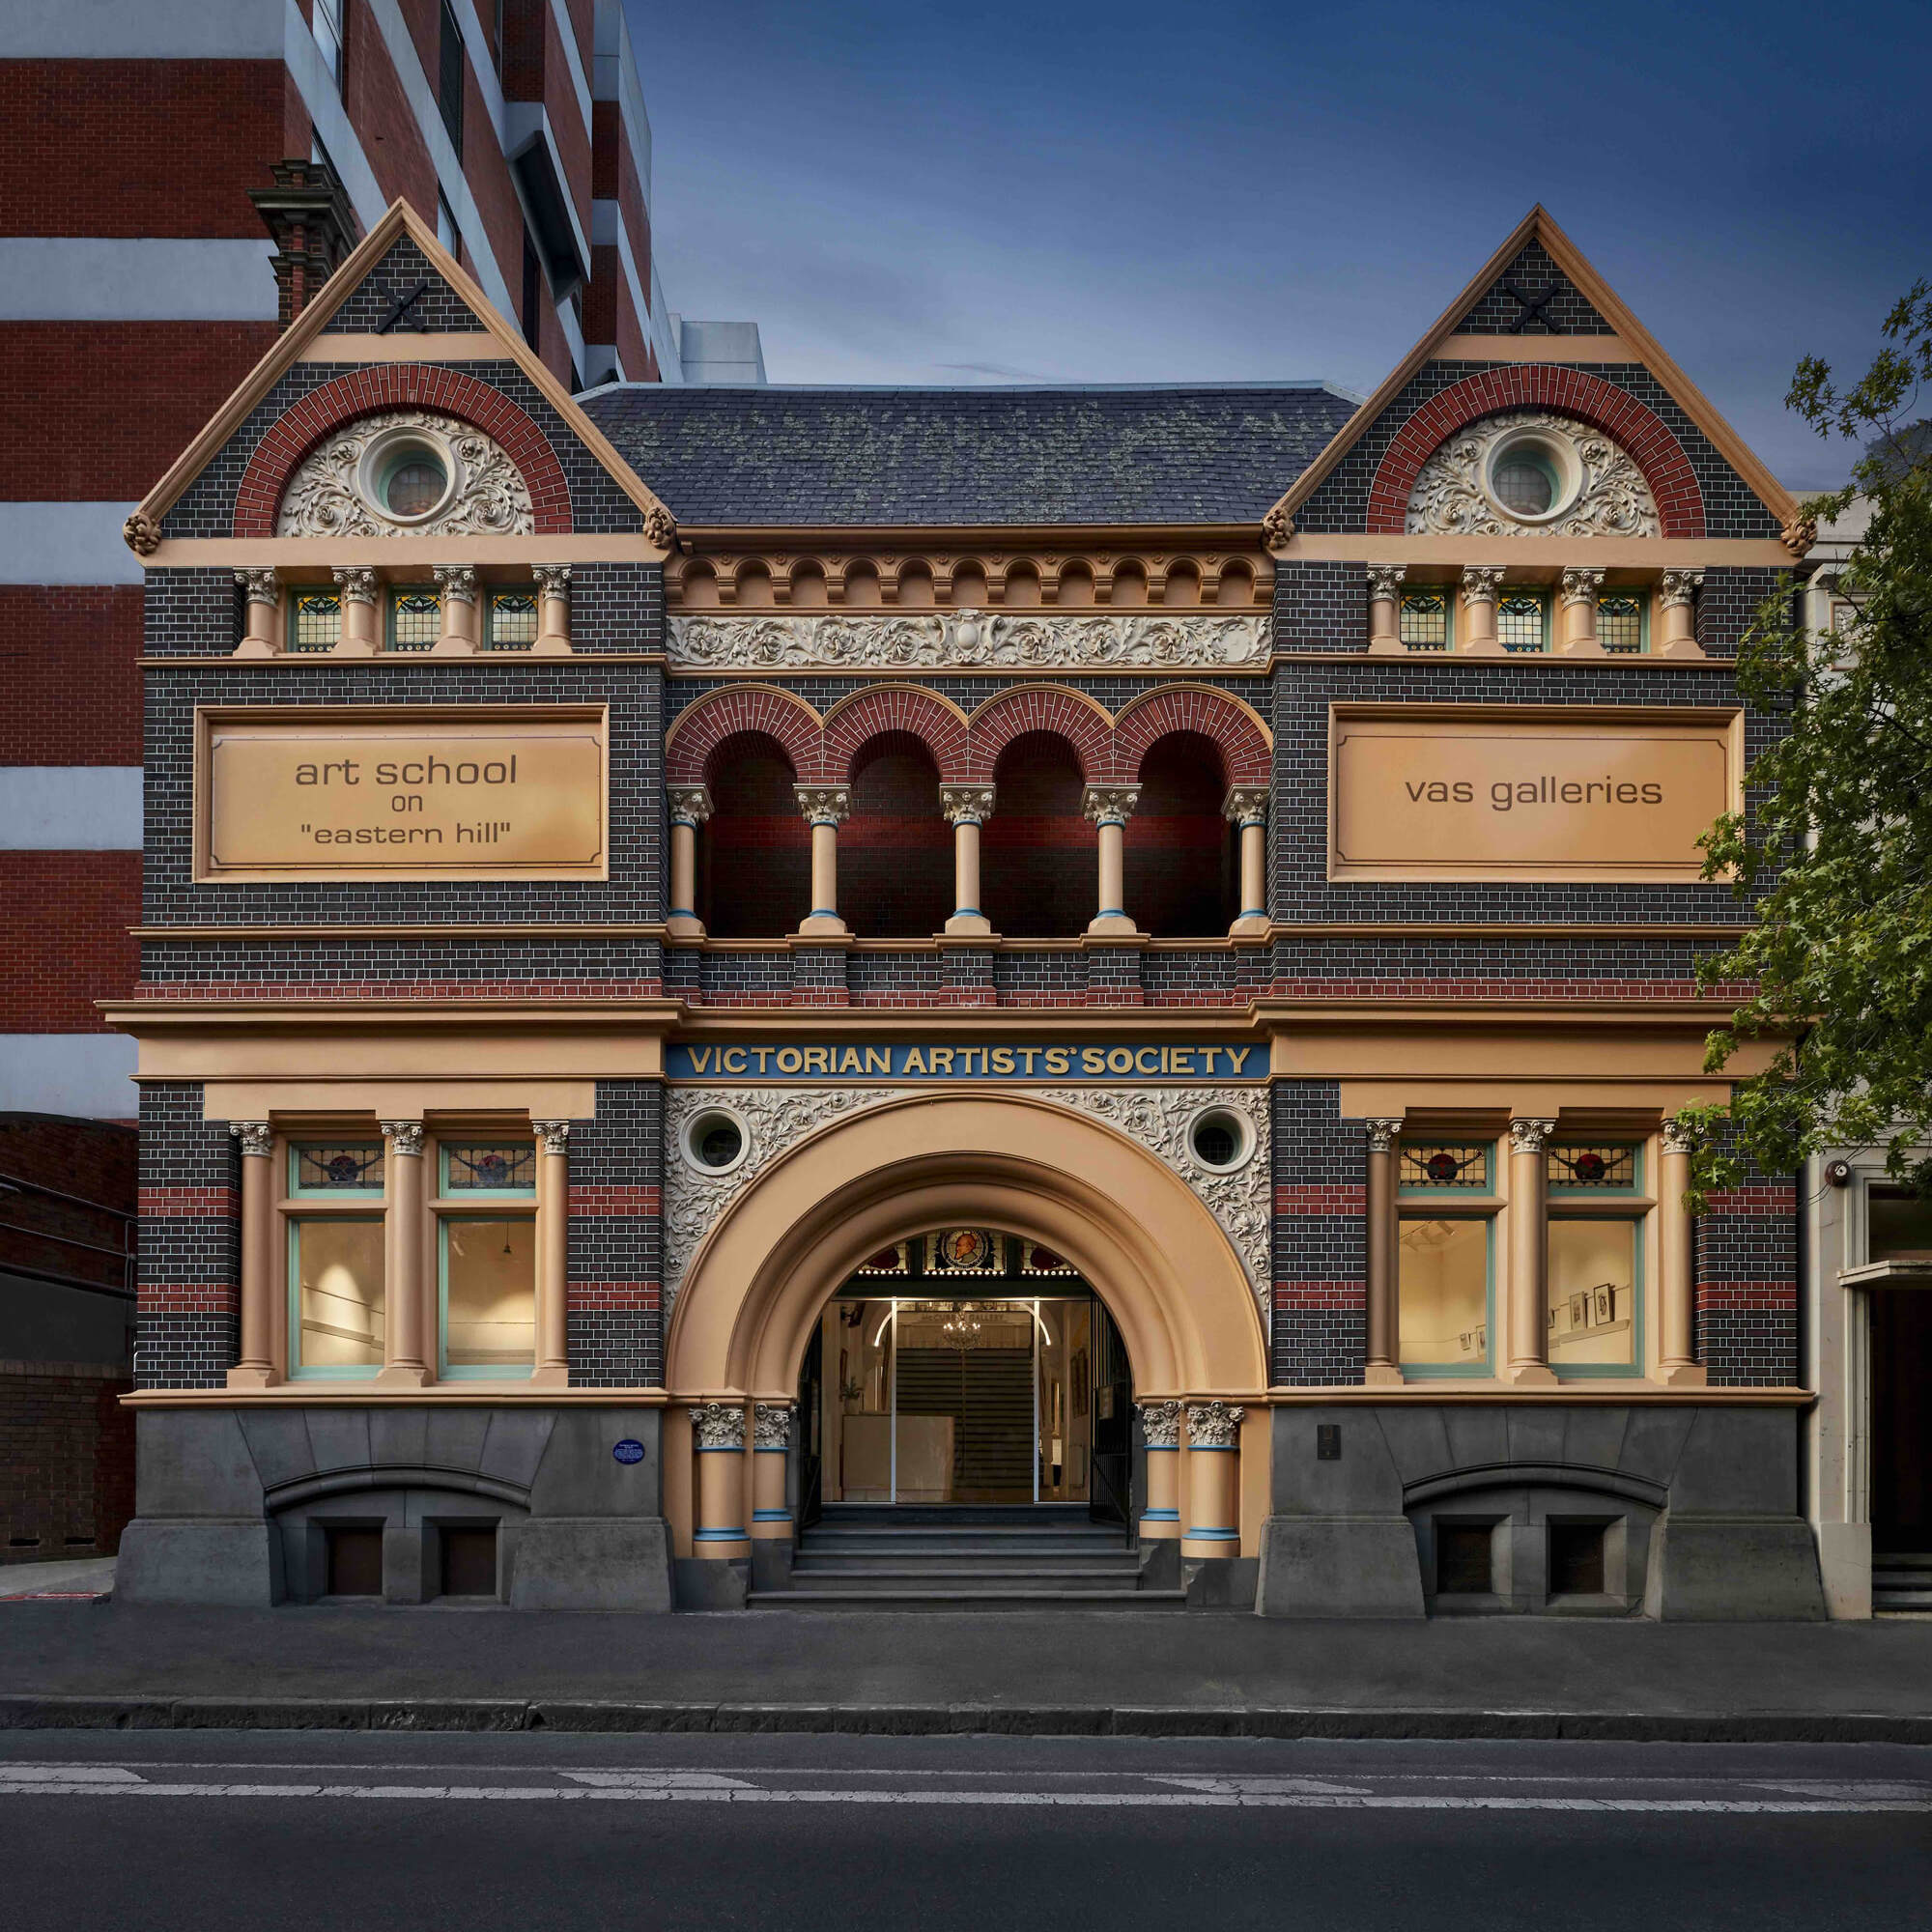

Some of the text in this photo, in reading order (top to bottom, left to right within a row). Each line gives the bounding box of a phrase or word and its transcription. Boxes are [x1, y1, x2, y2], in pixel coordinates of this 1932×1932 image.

[295, 753, 517, 786] art school
[391, 795, 423, 812] on
[1405, 775, 1663, 812] vas galleries
[300, 821, 511, 844] "eastern hill"
[689, 1047, 891, 1074] VICTORIAN
[1081, 1047, 1252, 1074] SOCIETY
[969, 1313, 1004, 1321] GALLERY
